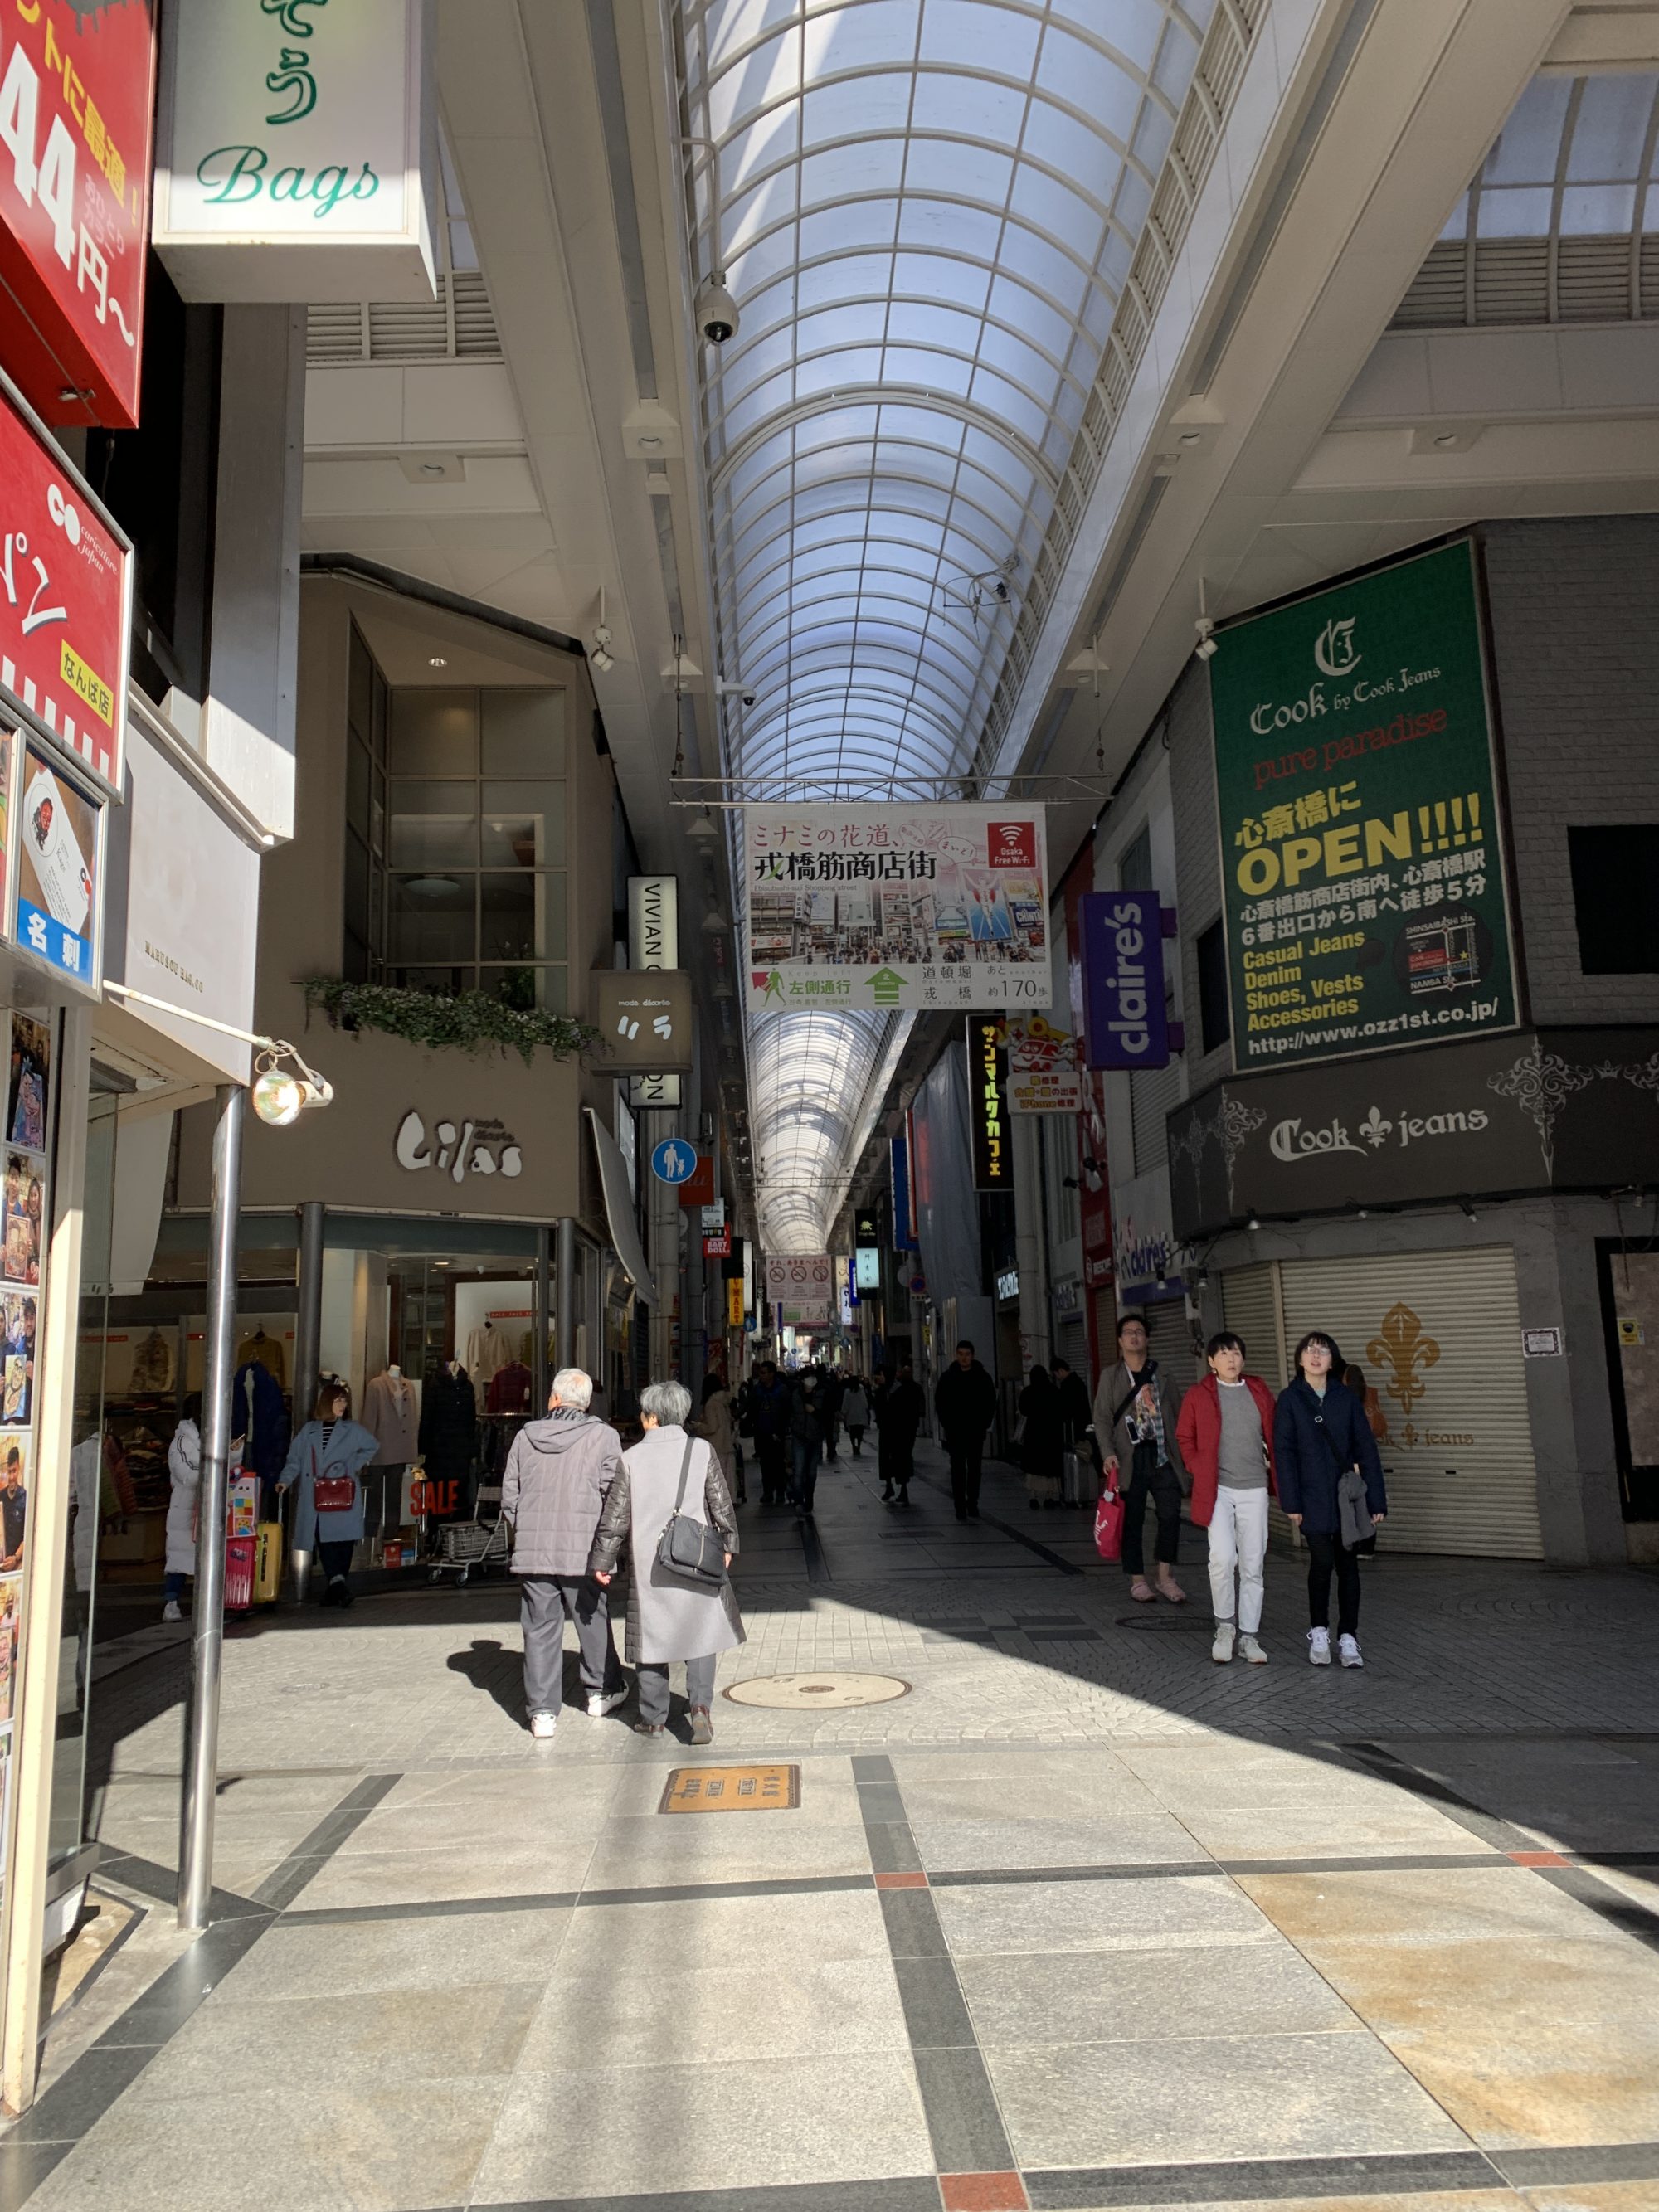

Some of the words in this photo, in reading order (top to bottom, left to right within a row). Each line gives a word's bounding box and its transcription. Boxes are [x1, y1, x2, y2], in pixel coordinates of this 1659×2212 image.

[197, 145, 379, 218] Bags
[77, 542, 105, 575] japan
[80, 526, 118, 576] caricature
[64, 652, 111, 719] なんば店
[1250, 682, 1329, 735] Cook
[1334, 693, 1351, 711] by
[1354, 677, 1395, 702] Cook
[1398, 667, 1442, 693] Jeans
[1253, 746, 1318, 791] pure
[1321, 707, 1447, 771] paradise
[1234, 780, 1362, 849] 心斎橋に
[753, 851, 937, 881] 戎橋筋商店街
[995, 855, 1010, 865] Free
[1000, 847, 1024, 856] Osaka
[804, 883, 836, 894] Shopping
[837, 884, 858, 892] street
[645, 883, 662, 955] VIVIAN
[27, 912, 80, 972] 名刺
[1243, 943, 1304, 970] Casual
[1309, 931, 1366, 957] Jeans
[788, 980, 852, 995] 左側通行
[922, 965, 972, 980] 道頓堀
[1244, 965, 1302, 991] Denim
[1410, 978, 1442, 989] NAMBA
[1246, 986, 1306, 1012] Shoes,
[1311, 974, 1365, 1000] Vests
[1248, 996, 1360, 1032] Accessories
[1248, 995, 1500, 1056] http://www.ozz1st.co.jp/
[1270, 1117, 1369, 1162] Cook
[1398, 1109, 1489, 1148] jeans
[410, 1480, 460, 1517] SALE
